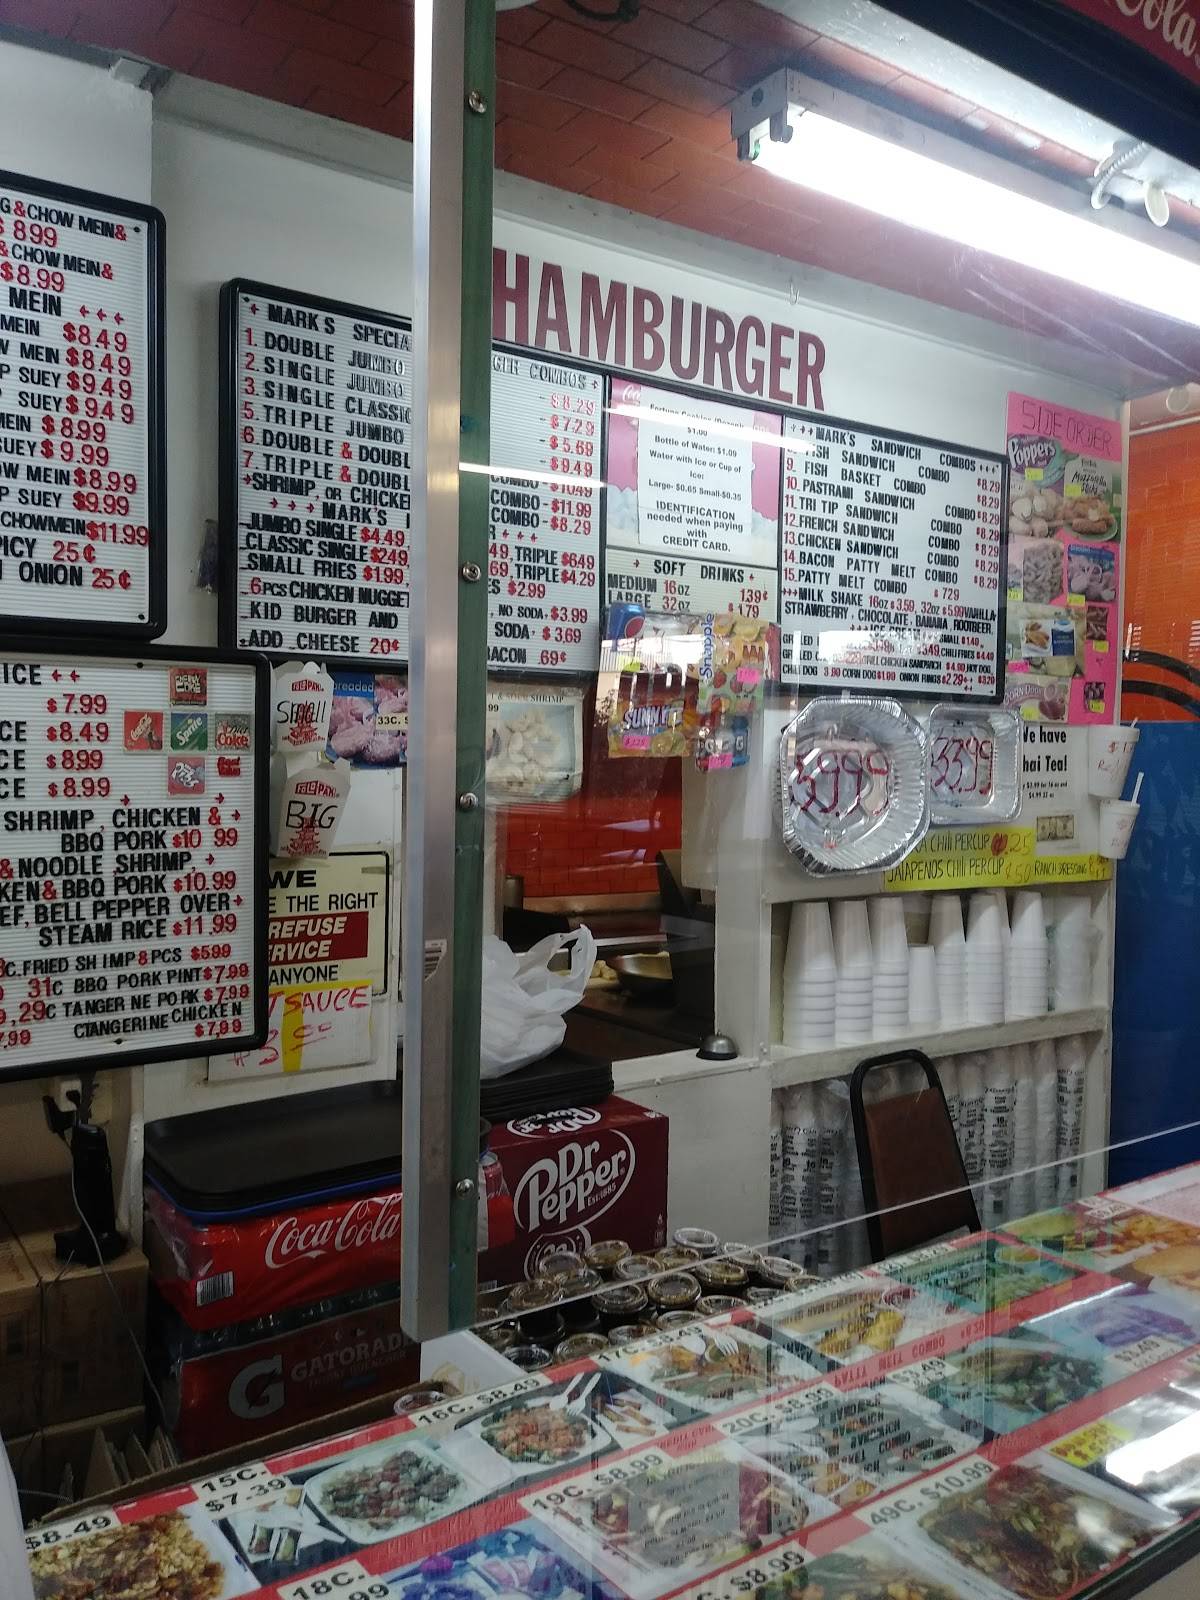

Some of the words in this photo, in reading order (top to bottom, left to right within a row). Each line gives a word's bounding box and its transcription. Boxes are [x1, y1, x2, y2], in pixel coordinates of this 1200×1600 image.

[9, 286, 62, 317] MEIN
[1, 315, 41, 336] MEIN
[63, 322, 128, 352] $8.49
[493, 247, 827, 412] HAMBURGER
[20, 342, 60, 365] MEIN
[65, 346, 131, 376] $8.49
[264, 331, 335, 363] DOUBLE
[19, 367, 62, 388] SUEY
[66, 370, 132, 400] $9.49
[264, 356, 335, 386] SINGLE
[18, 391, 62, 412] SUEY
[264, 381, 335, 410] SINGLE
[263, 405, 334, 433] TRIPLE
[346, 419, 405, 445] JUMBO
[1022, 400, 1063, 439] SIDE
[1066, 417, 1113, 456] ORDER
[40, 438, 109, 467] $9.99
[262, 429, 334, 457] DOUBLE
[681, 440, 690, 449] of
[816, 426, 856, 447] MARK'S
[871, 439, 921, 461] SANDWICH
[939, 453, 976, 472] COMBOS
[1008, 437, 1056, 469] Poppers
[262, 453, 334, 480] TRIPLE
[650, 449, 674, 461] Water
[676, 455, 693, 465] with
[695, 457, 707, 467] Ice
[709, 461, 717, 469] or
[718, 461, 733, 473] Cup
[734, 466, 742, 474] of
[842, 450, 895, 473] SANDWICH
[918, 465, 950, 483] COMBO
[26, 465, 71, 486] MEIN
[73, 467, 137, 494] $8.99
[805, 461, 828, 477] FISH
[841, 467, 881, 487] BASKET
[894, 478, 926, 495] COMBO
[18, 488, 62, 508] SUEY
[72, 491, 130, 516] $9.99
[325, 486, 342, 501] OR
[490, 489, 541, 511] COMBO
[803, 478, 854, 500] PASTRAMI
[864, 490, 915, 510] SANDWICH
[945, 504, 976, 521] COMBO
[322, 502, 388, 527] MARK'S
[491, 507, 540, 529] COMBO
[647, 511, 683, 525] needed
[685, 518, 711, 528] when
[713, 521, 744, 534] paying
[656, 500, 736, 522] IDENTIFICATION
[799, 496, 816, 512] TRI
[821, 500, 839, 515] TIP
[846, 504, 898, 525] SANDWICH
[931, 519, 962, 535] COMBO
[85, 521, 149, 547] $11.99
[248, 512, 301, 535] JUMBO
[306, 520, 358, 543] SINGLE
[687, 528, 708, 539] with
[799, 515, 838, 533] FRENCH
[843, 521, 895, 541] SANDWICH
[928, 535, 961, 551] COMBO
[245, 532, 314, 556] CLASSIC
[317, 540, 369, 563] SINGLE
[662, 535, 699, 549] CREDIT
[798, 533, 841, 552] CHICKEN
[847, 540, 899, 559] SANDWICH
[247, 552, 305, 576] SMALL
[314, 559, 357, 581] FRIES
[514, 546, 558, 567] TRIPLE
[800, 551, 835, 568] BACON
[847, 557, 880, 574] PATTY
[891, 564, 916, 579] MELT
[925, 569, 958, 584] COMBO
[19, 561, 83, 586] ONION
[514, 564, 559, 583] TRIPLE
[607, 573, 657, 593] MEDIUM
[653, 559, 687, 577] SOFT
[700, 564, 745, 584] DRINKS
[798, 569, 831, 585] PATTY
[839, 574, 865, 590] MELT
[874, 578, 907, 594] COMBO
[289, 580, 355, 604] CHICKEN
[799, 587, 824, 602] MILK
[831, 591, 863, 607] SHAKE
[250, 601, 282, 620] KID
[294, 604, 358, 627] BURGER
[368, 611, 399, 630] AND
[498, 604, 513, 618] NO
[785, 602, 849, 620] STRAWBERRY
[916, 614, 948, 630] BANANA
[248, 629, 284, 649] ADD
[296, 631, 360, 653] CHEESE
[701, 612, 715, 679] Snapple
[176, 715, 204, 746] Sprite
[1040, 725, 1067, 743] have
[1045, 754, 1068, 773] Tea!
[112, 807, 201, 829] CHICKEN
[285, 800, 338, 829] BIG
[61, 832, 104, 854] BBQ
[114, 829, 168, 852] PORK
[18, 855, 103, 879] NOODLE
[62, 877, 105, 898] BBQ
[114, 875, 168, 897] PORK
[173, 870, 237, 893] $10.99
[34, 901, 87, 925] BELL
[93, 896, 170, 921] PEPPER
[180, 893, 231, 914] OVER
[286, 895, 319, 913] THE
[328, 892, 379, 911] RIGHT
[39, 922, 113, 948] STEAM
[121, 918, 168, 941] RICE
[172, 912, 238, 936] $11.99
[269, 916, 347, 939] REFUSE
[74, 976, 108, 994] BBQ
[117, 971, 161, 990] PORK
[167, 966, 203, 986] PINT
[269, 964, 339, 987] ANYONE
[171, 1002, 242, 1023] CHICKEN
[558, 1140, 600, 1188] Dr
[515, 1150, 626, 1233] Pepper
[265, 1193, 402, 1270] Coca-Cola
[229, 1355, 285, 1420] G
[25, 1514, 113, 1551] $8.49
